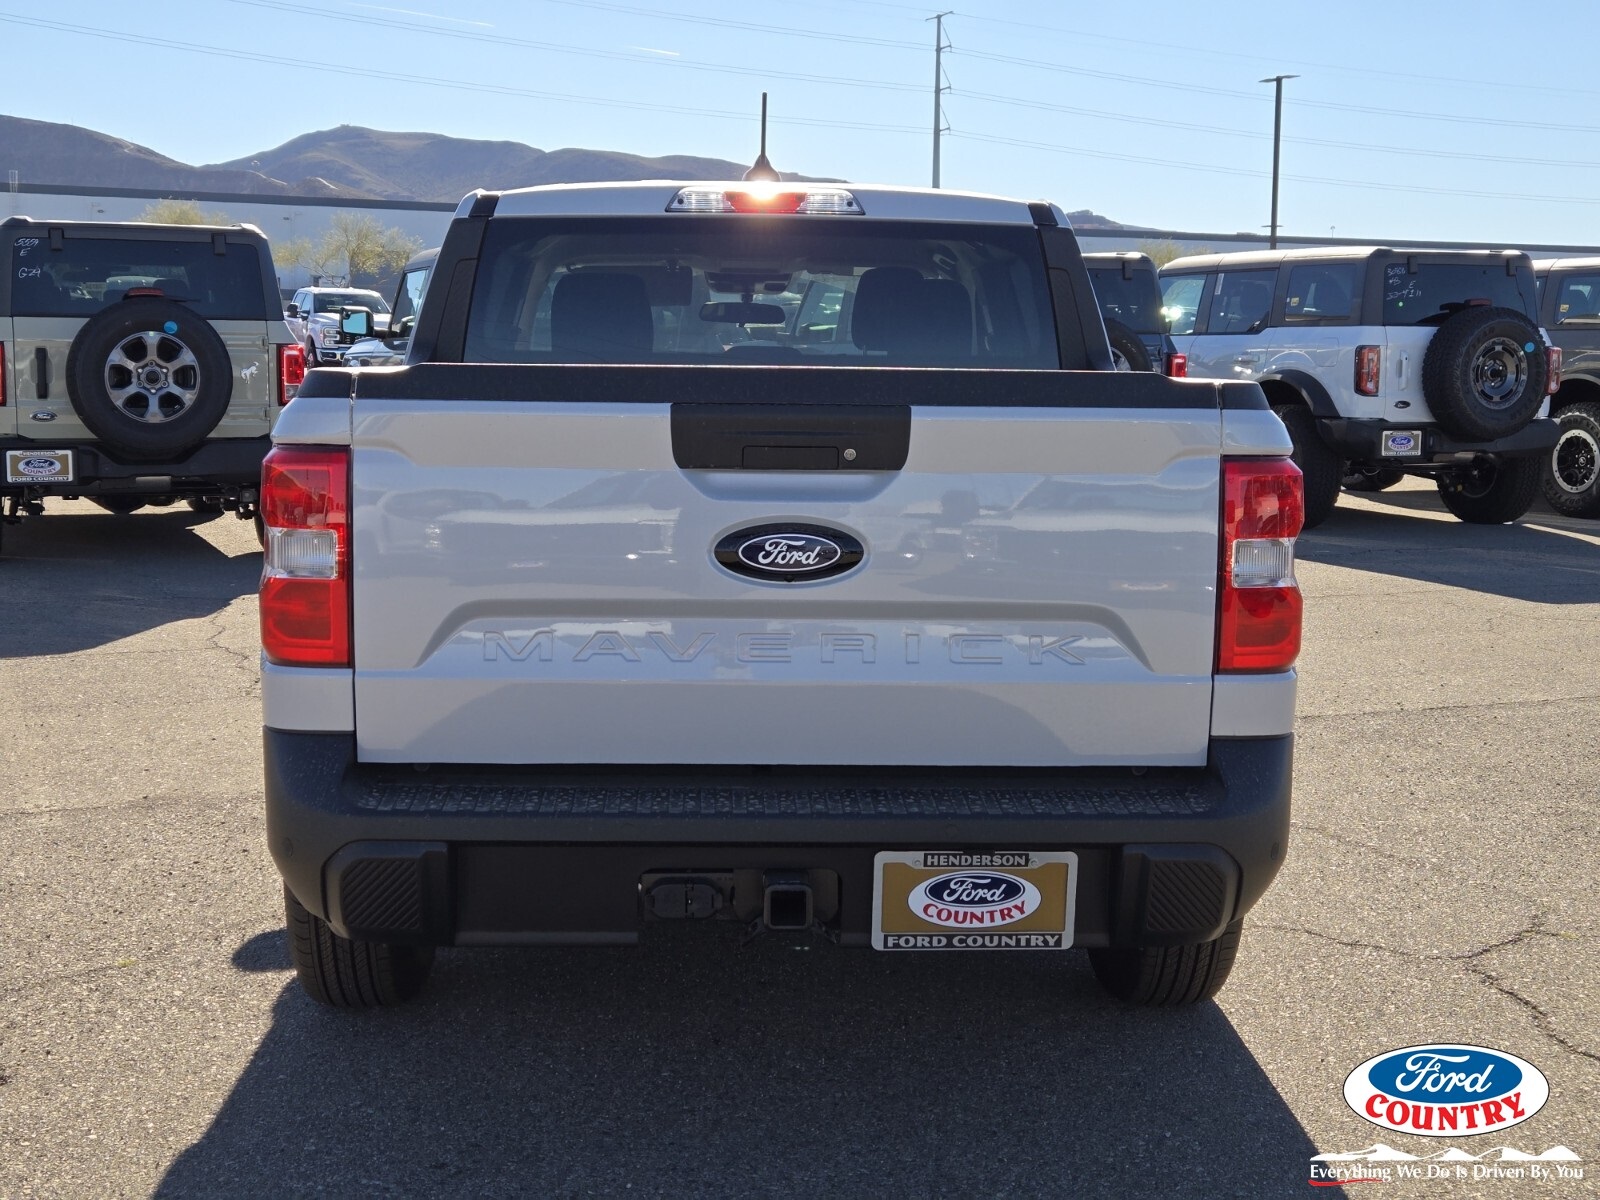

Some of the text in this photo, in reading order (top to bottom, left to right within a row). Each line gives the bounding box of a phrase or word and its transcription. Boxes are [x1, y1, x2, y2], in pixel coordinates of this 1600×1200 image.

[22, 466, 56, 475] COUNTRY
[29, 459, 50, 467] Ford
[758, 538, 821, 565] Ford
[483, 630, 1086, 665] MAVERICK
[926, 854, 1026, 867] HENDERSON
[943, 877, 1007, 902] Ford
[922, 901, 1026, 925] COUNTRY
[887, 935, 1060, 948] FORD COUNTRY
